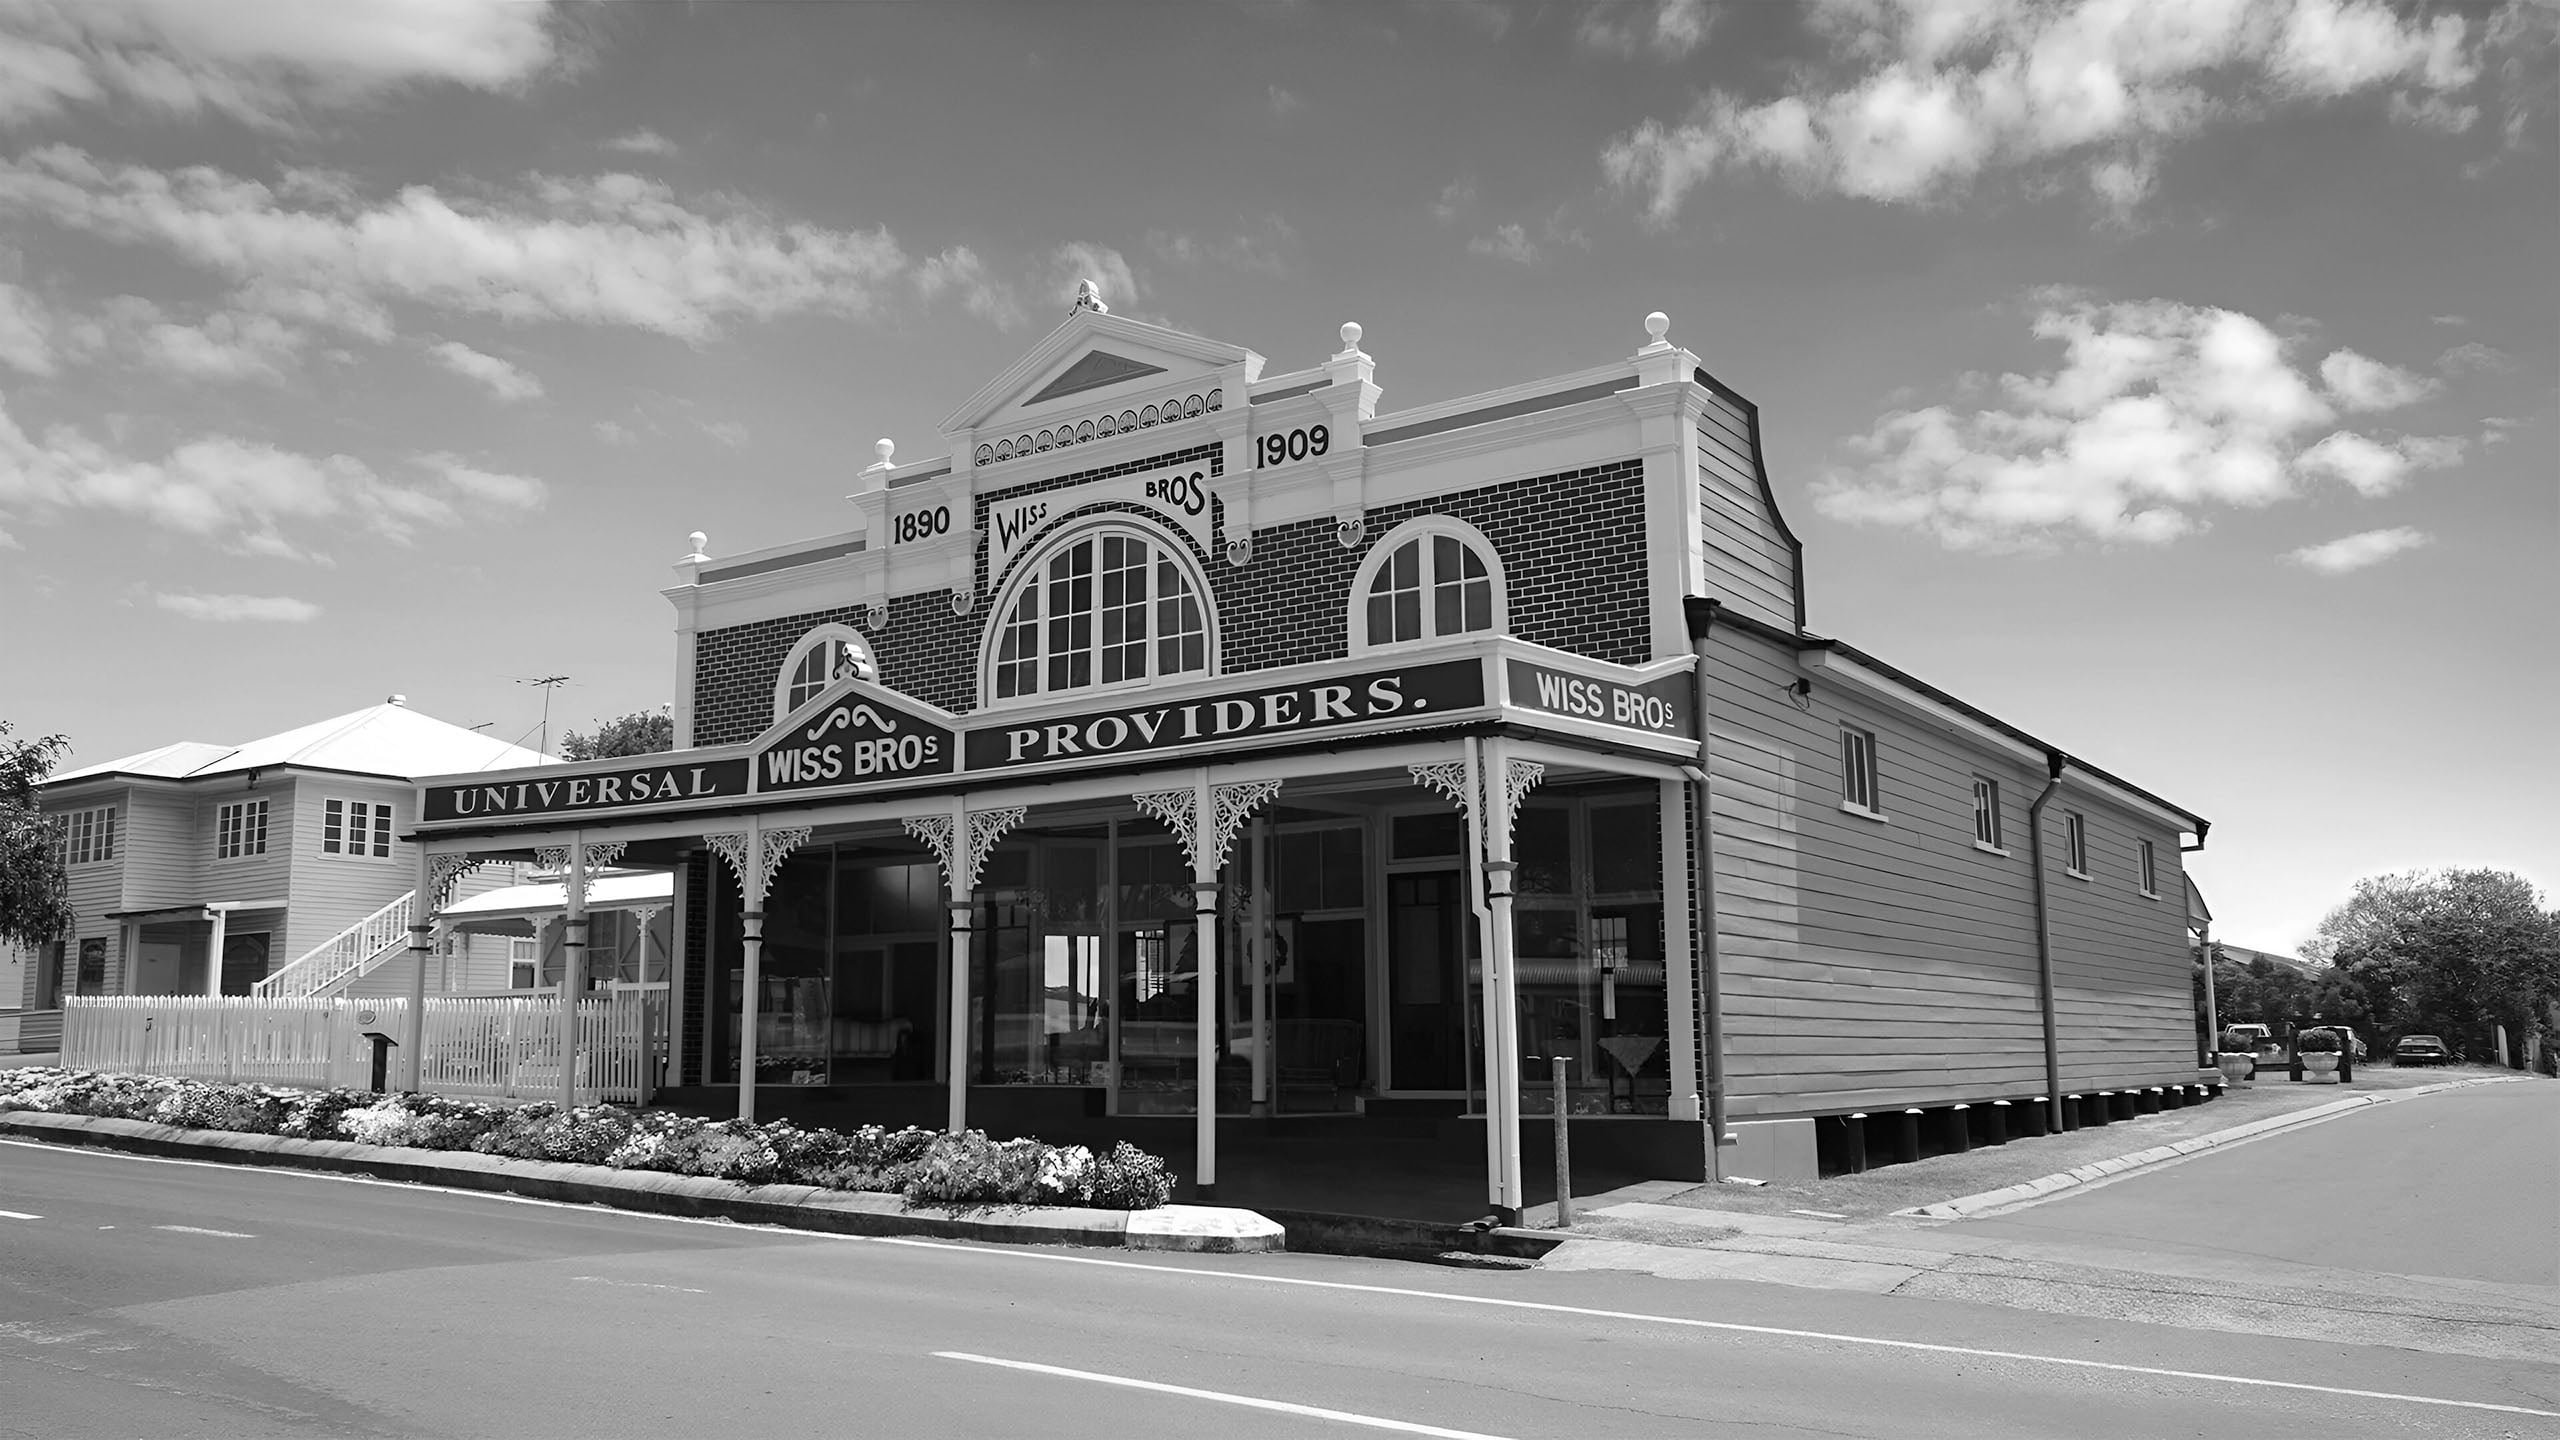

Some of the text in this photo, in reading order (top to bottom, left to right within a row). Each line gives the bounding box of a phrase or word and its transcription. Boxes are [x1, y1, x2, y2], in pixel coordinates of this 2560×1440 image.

[1256, 424, 1330, 469] 1909
[894, 505, 950, 545] 1890
[996, 471, 1206, 554] WISS BROS
[1536, 672, 1604, 717] WISS
[1005, 676, 1427, 761] PROVIDERS.
[768, 745, 842, 785] WISS
[454, 768, 717, 814] UNIVERSAL
